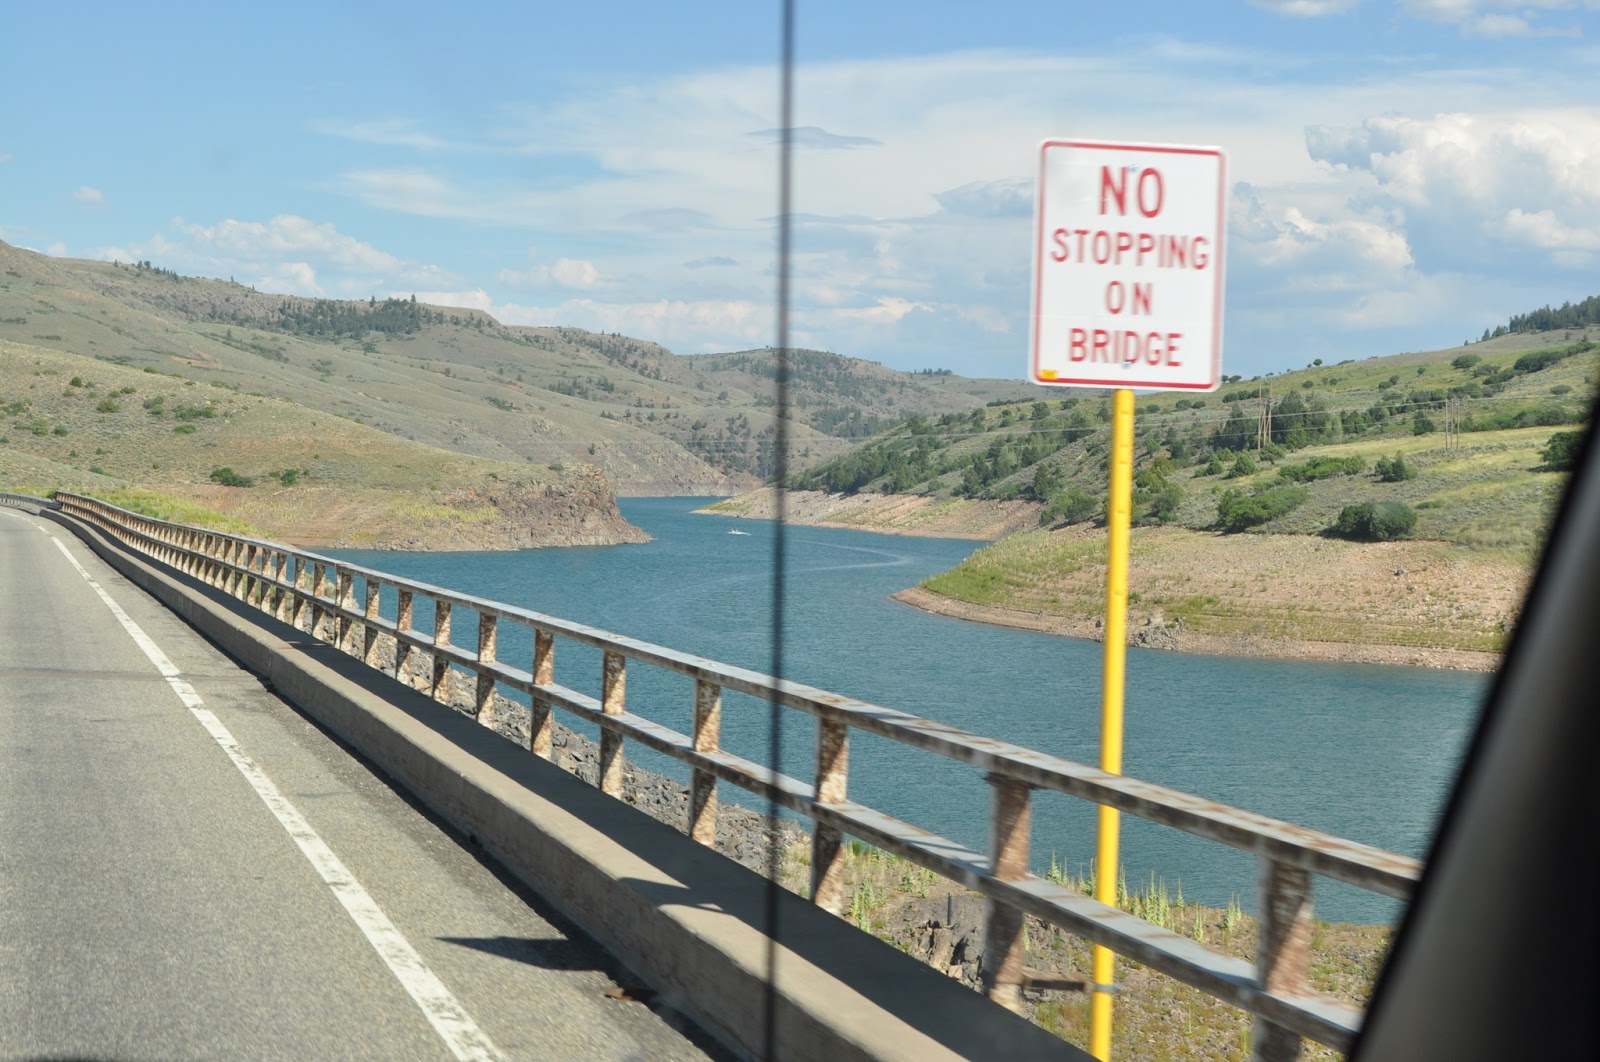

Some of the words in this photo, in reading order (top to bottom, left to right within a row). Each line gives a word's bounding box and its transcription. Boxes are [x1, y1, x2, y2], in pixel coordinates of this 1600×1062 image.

[1098, 165, 1165, 218] NO
[1051, 227, 1210, 271] STOPPING
[1105, 280, 1153, 316] ON
[1068, 327, 1183, 367] BRIDGE
